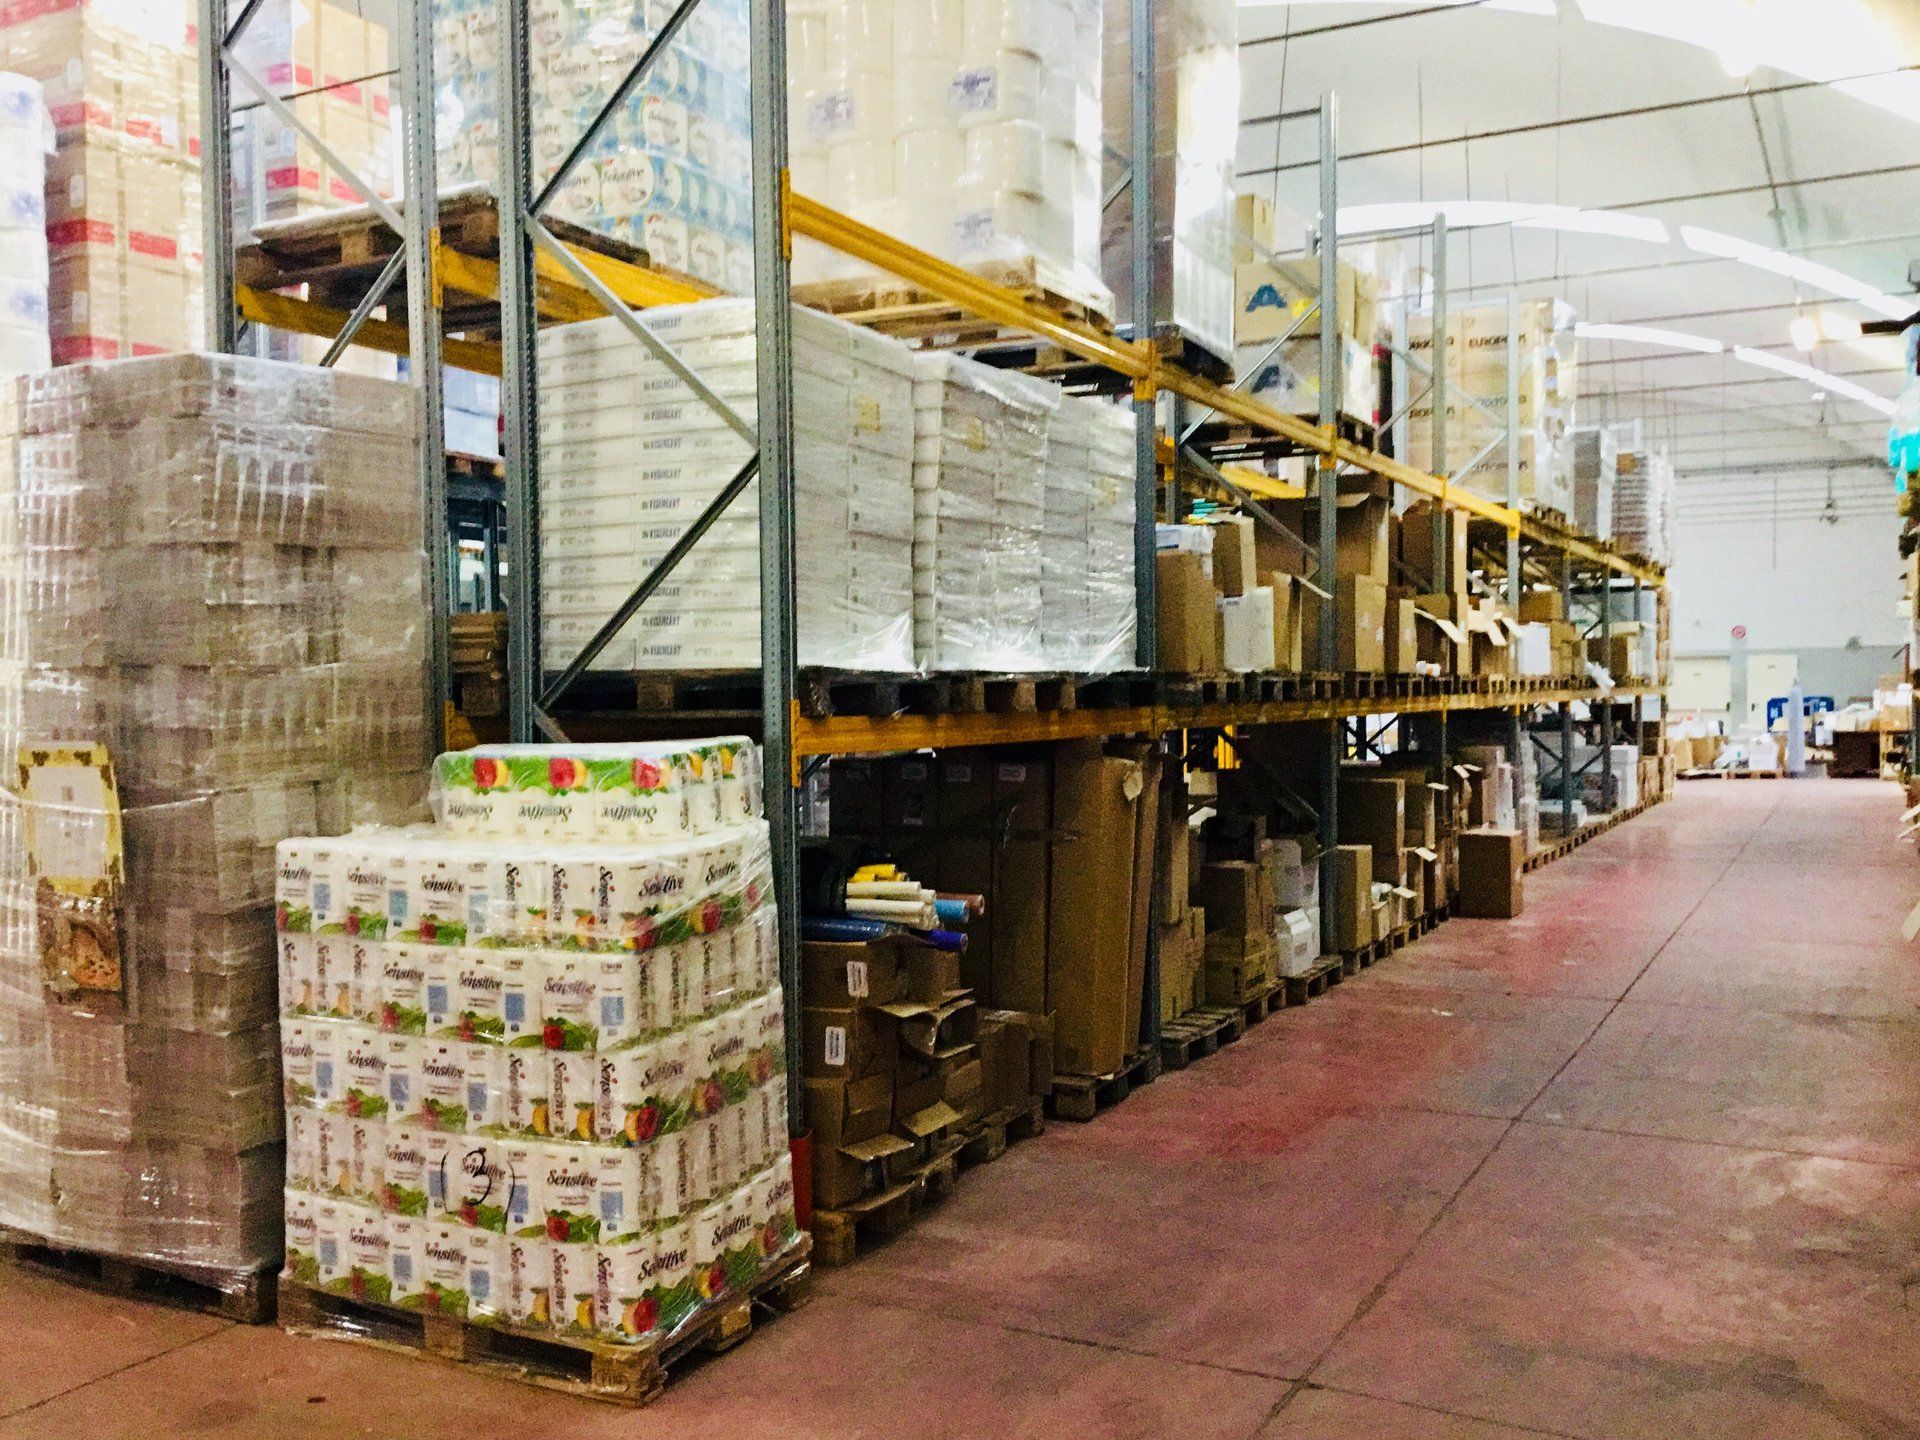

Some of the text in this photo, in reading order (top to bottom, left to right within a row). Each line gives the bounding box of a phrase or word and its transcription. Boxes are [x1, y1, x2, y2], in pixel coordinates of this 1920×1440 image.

[518, 803, 573, 823] Sensitive
[601, 803, 658, 824] Sensitive
[421, 874, 466, 893] Sensitive
[459, 969, 503, 991] Sensitive
[544, 975, 597, 995] Sensitive
[347, 1050, 389, 1072] Sensitive
[421, 1058, 466, 1080] Sensitive
[546, 1167, 598, 1188] Sensitive
[711, 1213, 753, 1247] Sensitive
[424, 1241, 467, 1265] Sensitive
[638, 1248, 689, 1285] Sensitive
